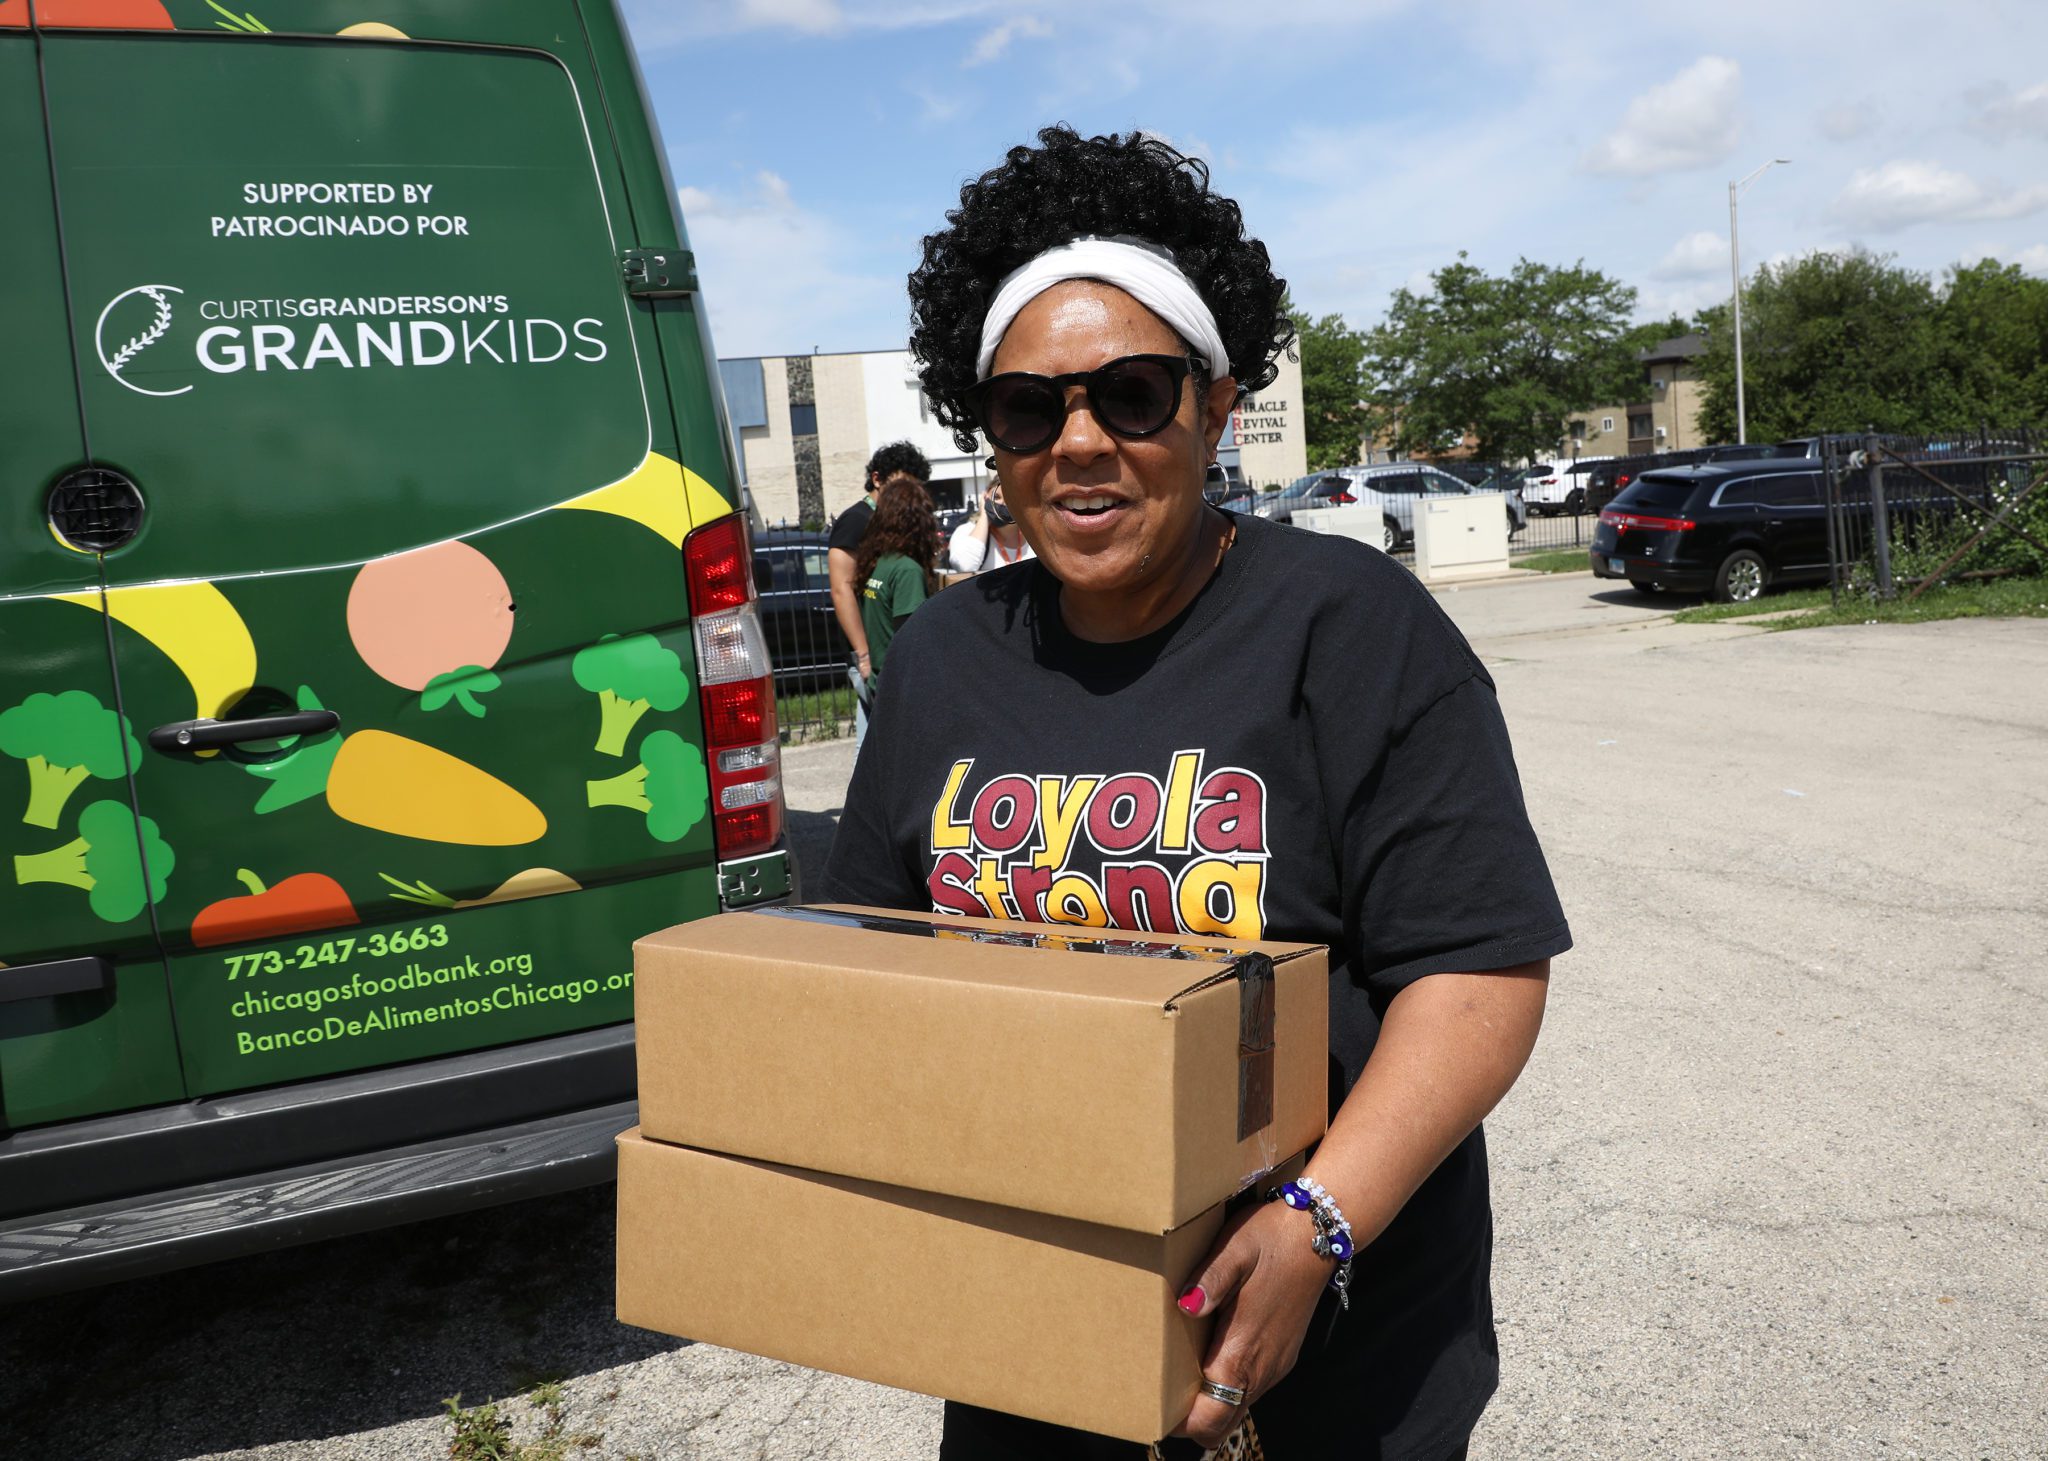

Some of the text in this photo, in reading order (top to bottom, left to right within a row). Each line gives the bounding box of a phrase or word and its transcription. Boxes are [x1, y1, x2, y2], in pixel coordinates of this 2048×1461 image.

[243, 182, 434, 204] SUPPORTED BY
[210, 215, 470, 237] PATROCINADO POR
[195, 317, 608, 374] GRANDKIDS
[1232, 417, 1287, 431] REVIVAL
[1233, 432, 1283, 446] CENTER
[931, 748, 1272, 873] Loyola
[927, 852, 1267, 941] Strong
[223, 923, 450, 981] 773-247-3663
[231, 953, 534, 1018] chicagosfoodbank.org
[236, 972, 634, 1055] BancoDeAlimentosChicago.or
